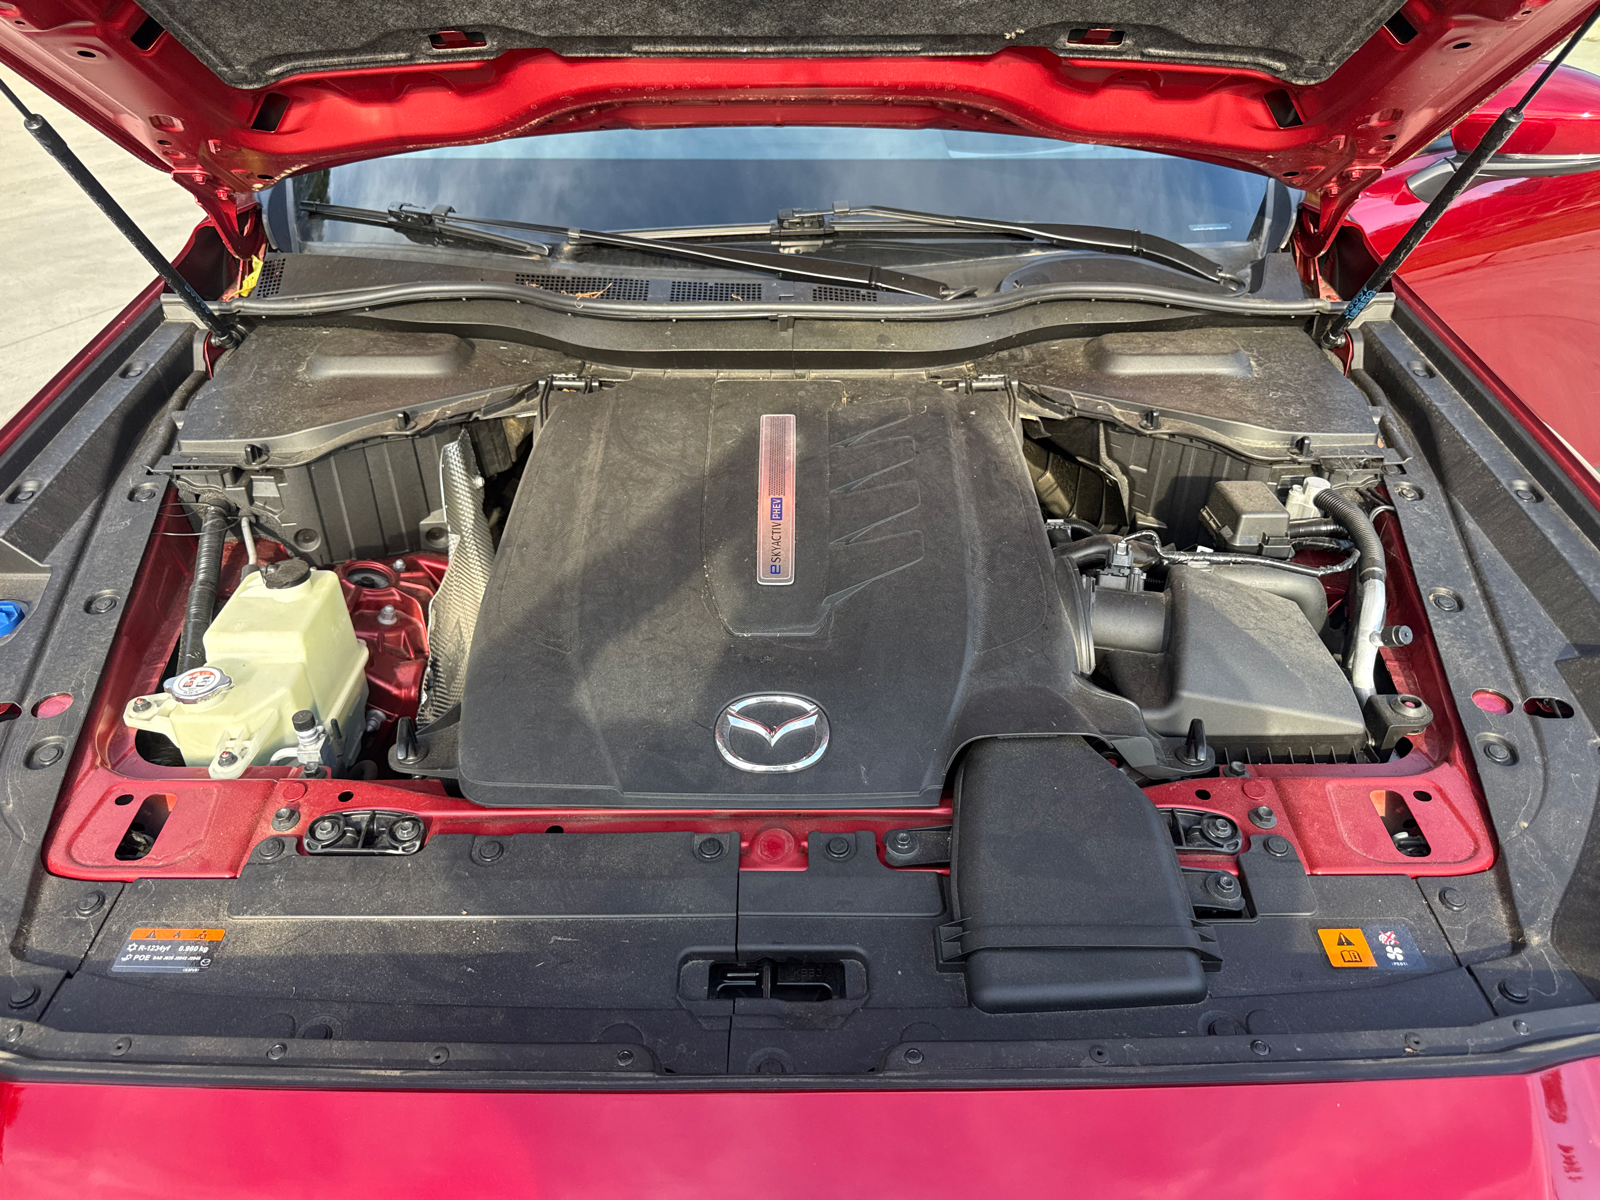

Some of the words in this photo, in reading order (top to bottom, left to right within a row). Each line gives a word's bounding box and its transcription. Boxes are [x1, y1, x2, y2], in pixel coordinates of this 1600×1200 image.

[772, 498, 781, 519] PHEV
[771, 522, 781, 563] SKYACTIV
[138, 945, 171, 953] R-1234yf
[199, 945, 209, 953] kg
